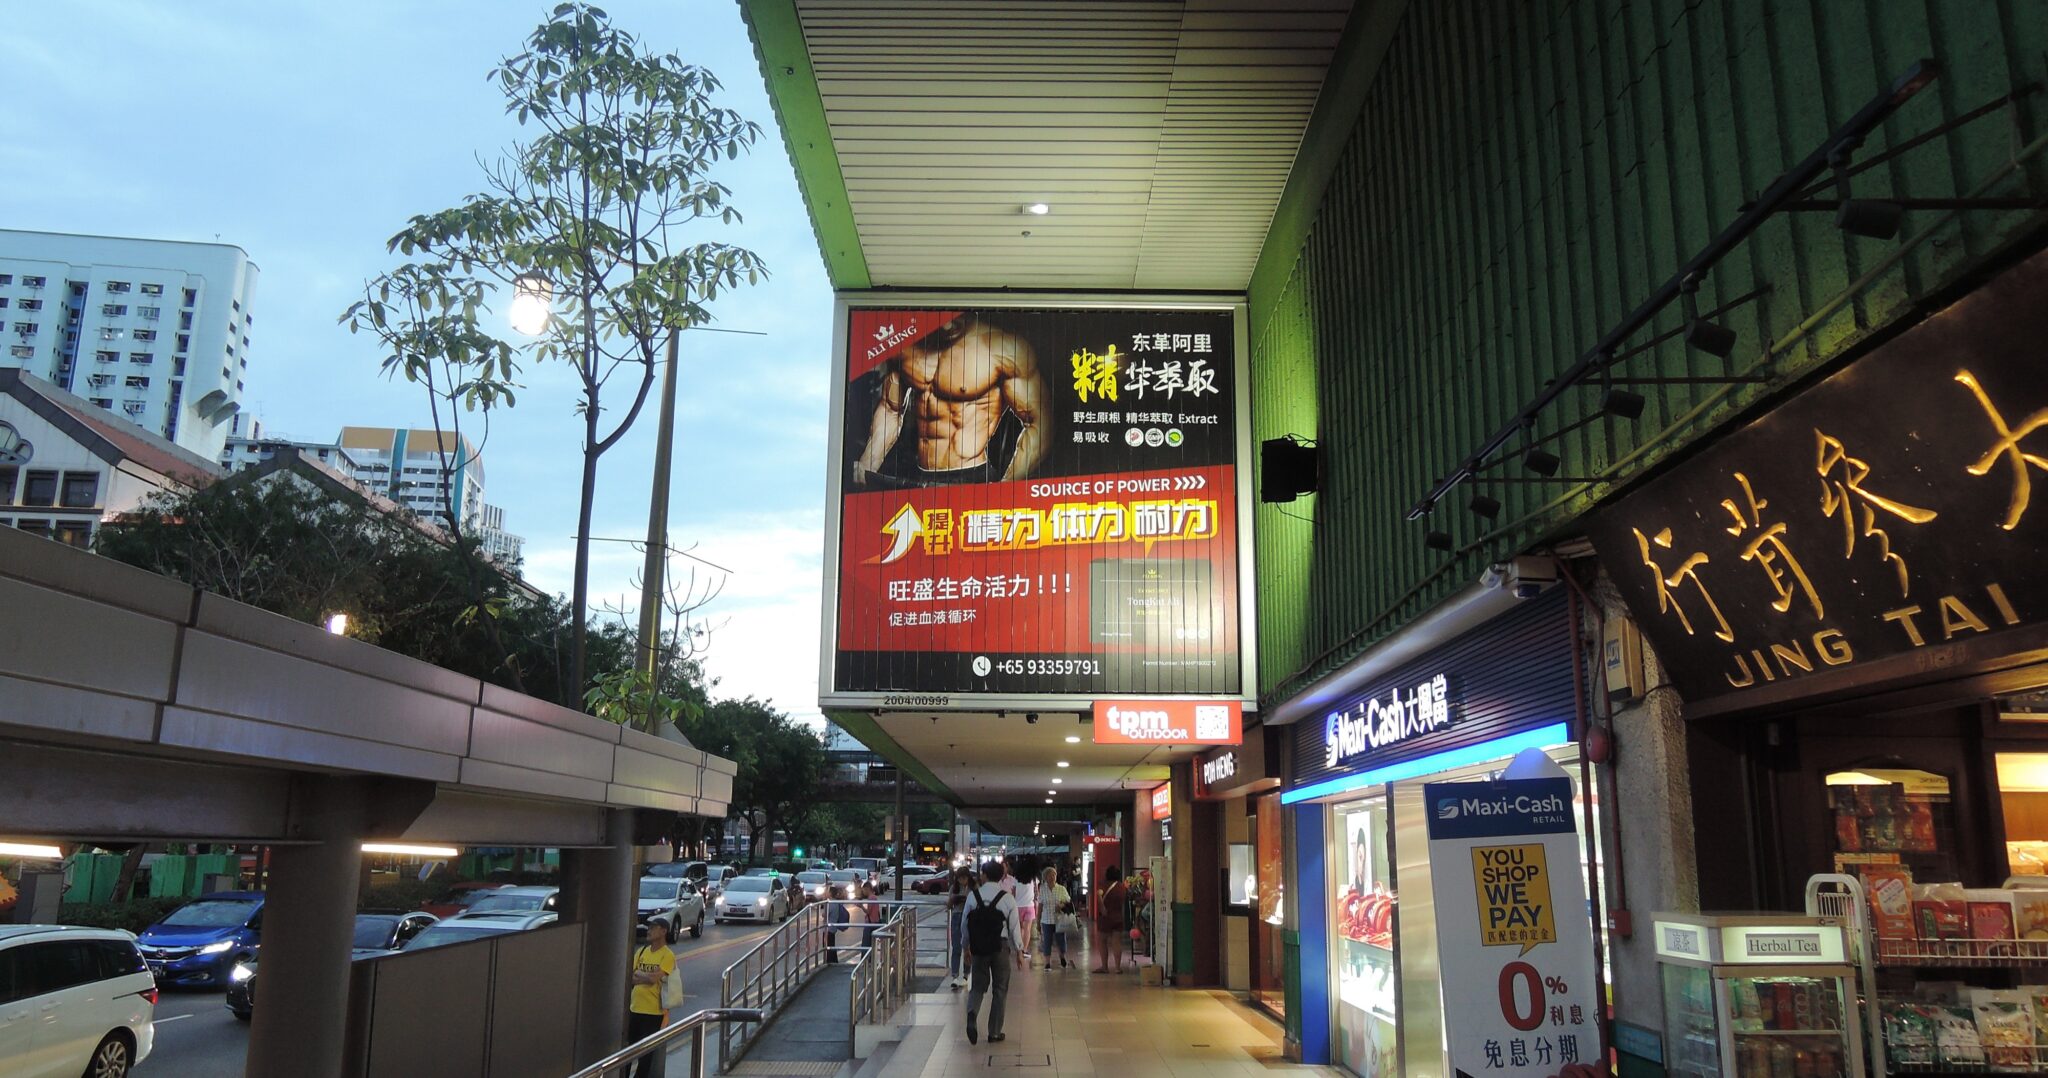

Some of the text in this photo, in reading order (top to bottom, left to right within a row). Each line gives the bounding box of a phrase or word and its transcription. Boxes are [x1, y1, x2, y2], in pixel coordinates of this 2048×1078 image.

[867, 325, 917, 360] ALI KING
[1132, 333, 1213, 354] 东革阿里
[1073, 411, 1218, 424] 野生原根 精华萃取 Extract
[1073, 431, 1110, 443] 易吸收
[1030, 477, 1171, 498] SOURCE OF POWER
[927, 503, 1209, 553] 提升 精力 体力 耐力
[888, 608, 977, 627] 促进血液循环
[1725, 583, 2020, 688] JING TAI
[996, 659, 1100, 676] +65 93359791
[884, 695, 949, 705] 2004/00999
[1106, 706, 1169, 736] tpm
[1338, 688, 1405, 750] Maxi-Cash
[1129, 728, 1188, 739] OUTDOOR
[1204, 760, 1216, 784] POH
[1215, 751, 1235, 780] HENG
[1462, 796, 1564, 818] Maxi-Cash
[1532, 816, 1565, 824] RETAIL
[1480, 848, 1524, 866] YOU
[1483, 865, 1539, 884] SHOP
[1484, 883, 1529, 906] WE
[1489, 905, 1542, 930] PAY
[1488, 929, 1549, 942] 匹配您的定金
[1750, 939, 1818, 952] Herbal Tea
[1550, 1004, 1584, 1026] 利息
[1484, 1034, 1579, 1069] 免息分期
